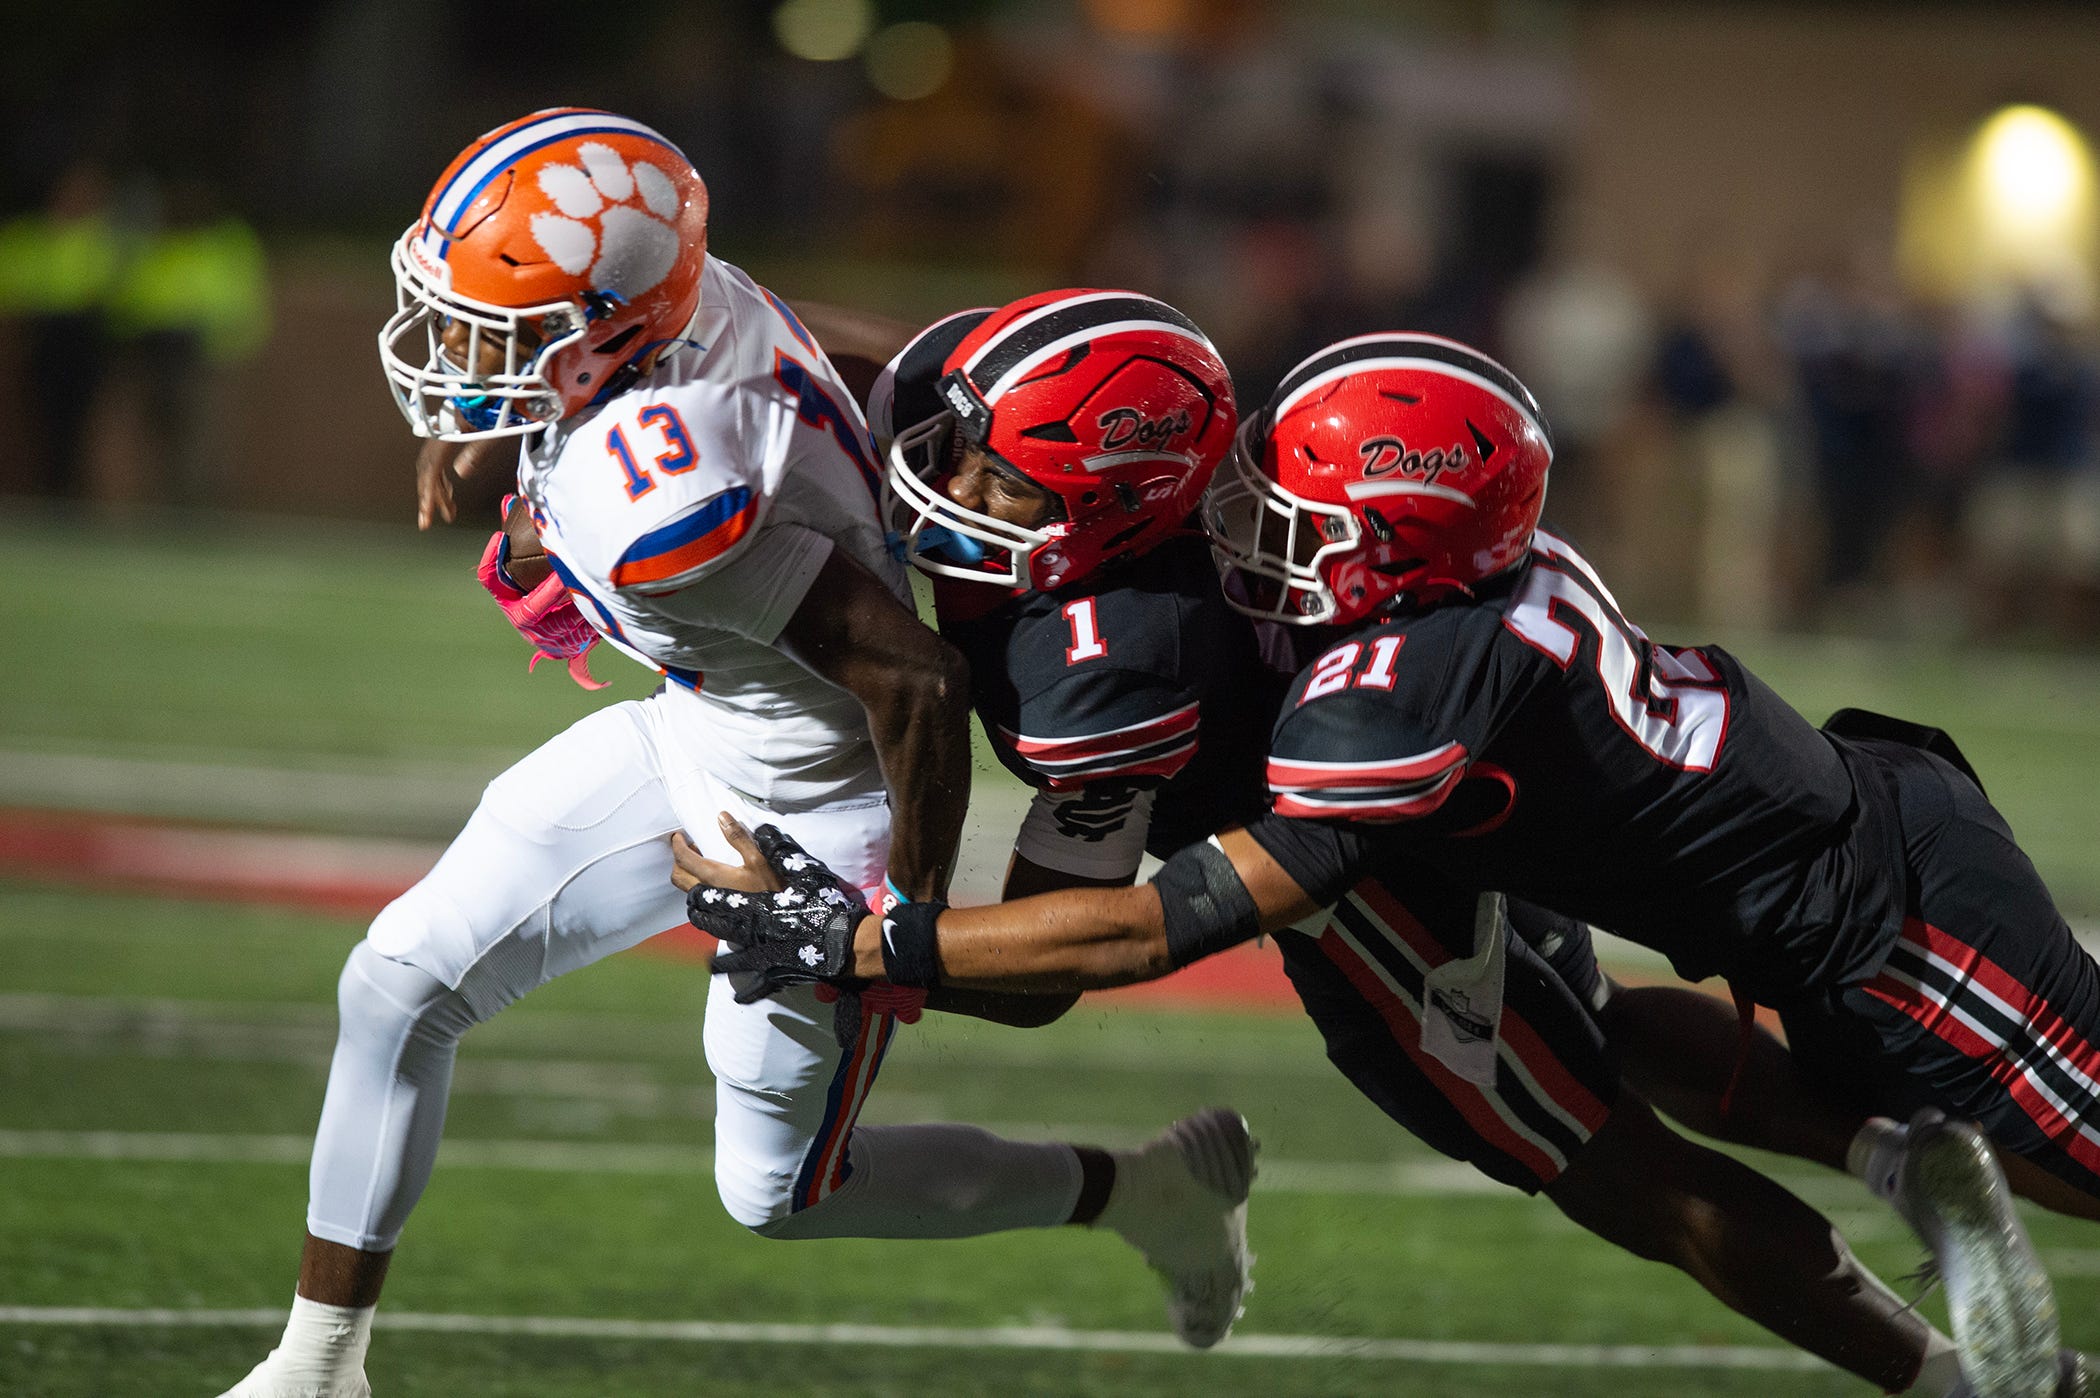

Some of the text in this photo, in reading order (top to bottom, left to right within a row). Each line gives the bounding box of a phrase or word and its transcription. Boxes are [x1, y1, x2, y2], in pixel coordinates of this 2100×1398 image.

[605, 402, 700, 503] 13
[1097, 406, 1193, 455] Dogs
[1359, 435, 1469, 487] Dogs
[1062, 595, 1108, 667] 1
[1296, 634, 1407, 708] 21
